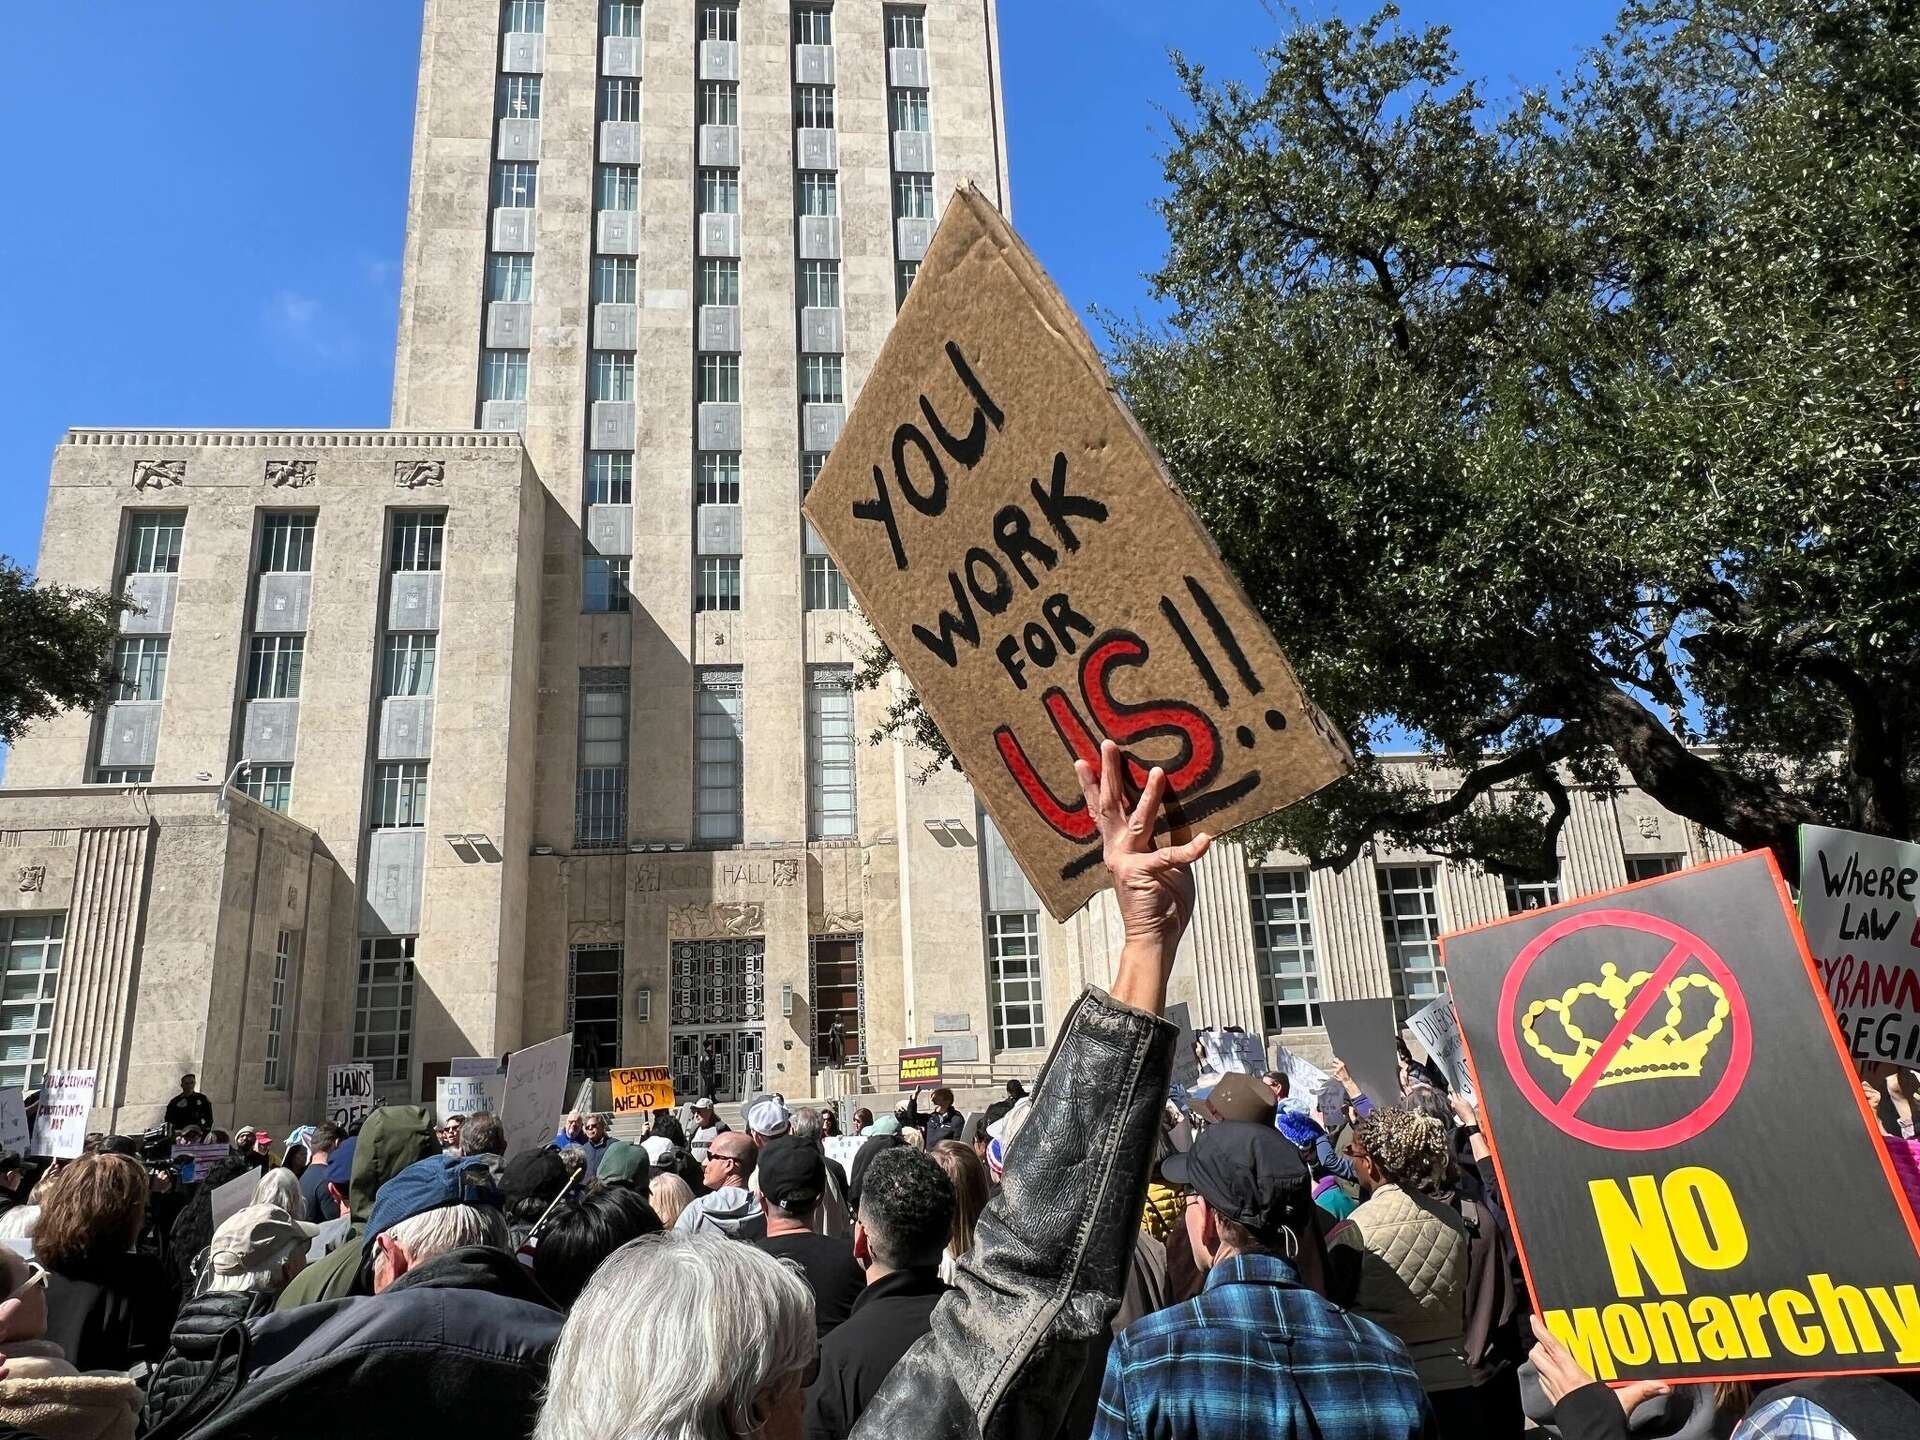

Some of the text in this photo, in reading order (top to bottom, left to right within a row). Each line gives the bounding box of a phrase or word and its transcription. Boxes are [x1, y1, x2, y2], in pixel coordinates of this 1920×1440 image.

[852, 340, 1004, 571] YOU
[911, 451, 1108, 668] WORK
[996, 592, 1095, 690] FOR
[722, 864, 768, 886] HALL
[1839, 902, 1901, 941] LAW
[1813, 953, 1920, 1013] YRANN
[1837, 1012, 1920, 1062] BEGI
[620, 1068, 671, 1085] CAUTION
[900, 1067, 939, 1079] FASCISM
[902, 1057, 937, 1069] REJECT
[333, 1069, 370, 1097] HANDS
[447, 1082, 485, 1095] GET THE
[614, 1093, 655, 1112] AHEAD
[1588, 1166, 1748, 1297] NO
[1543, 1273, 1920, 1380] Monarchy
